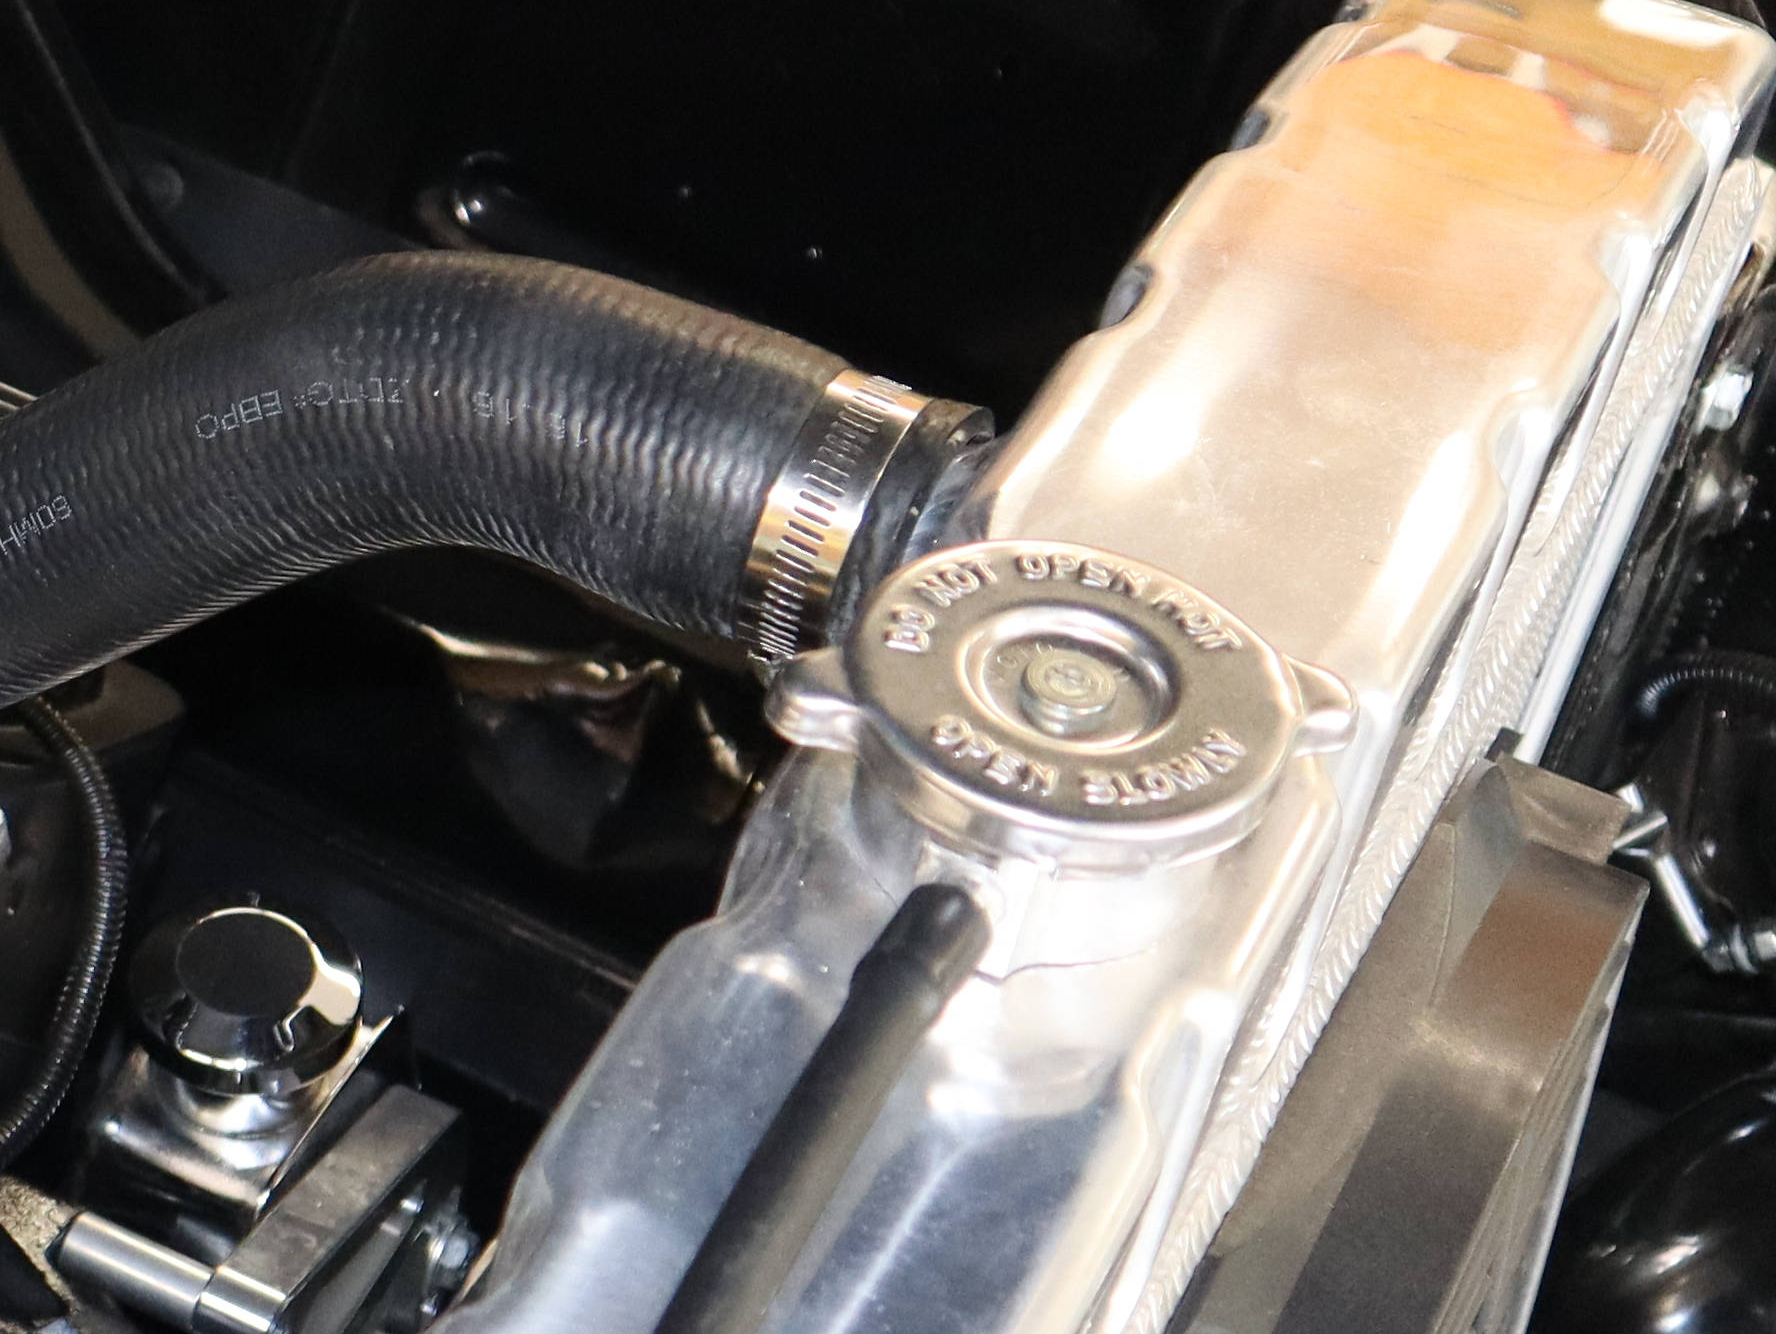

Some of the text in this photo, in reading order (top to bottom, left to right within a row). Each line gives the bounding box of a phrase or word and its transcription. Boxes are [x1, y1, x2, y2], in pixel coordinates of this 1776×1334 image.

[884, 604, 937, 655] DO
[913, 553, 998, 608] NOT
[1014, 552, 1150, 598] OPEN
[930, 713, 1061, 797] OPEN
